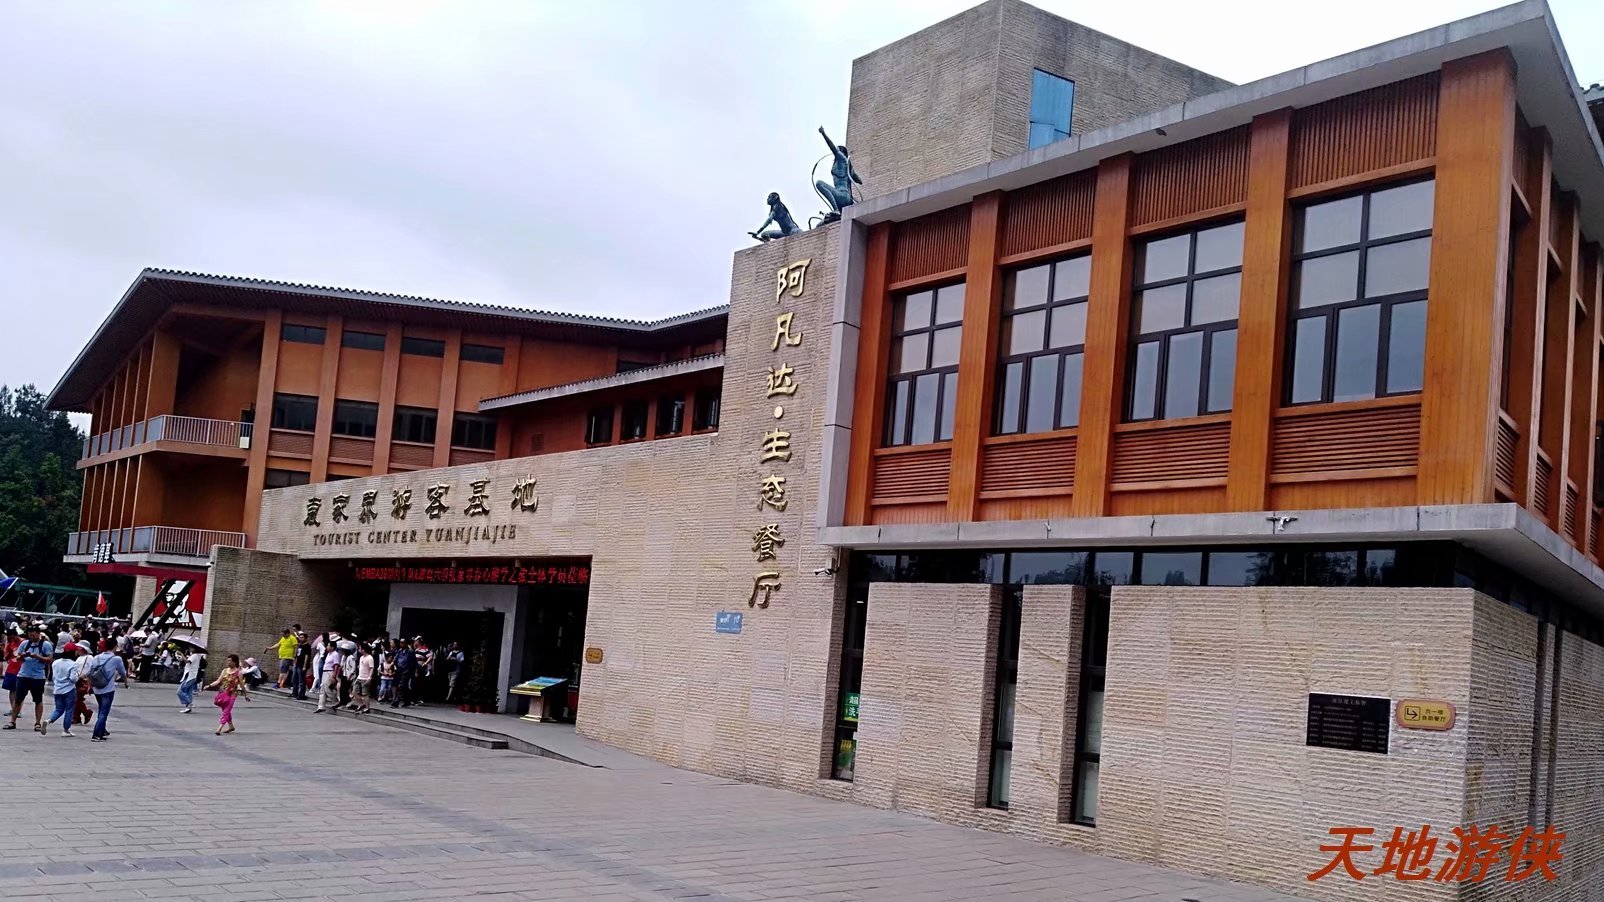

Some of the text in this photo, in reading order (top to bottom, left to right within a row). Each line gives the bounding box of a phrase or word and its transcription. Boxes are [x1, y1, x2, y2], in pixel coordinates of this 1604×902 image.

[313, 524, 517, 546] TOURIST CENTER YUANJIAJIE
